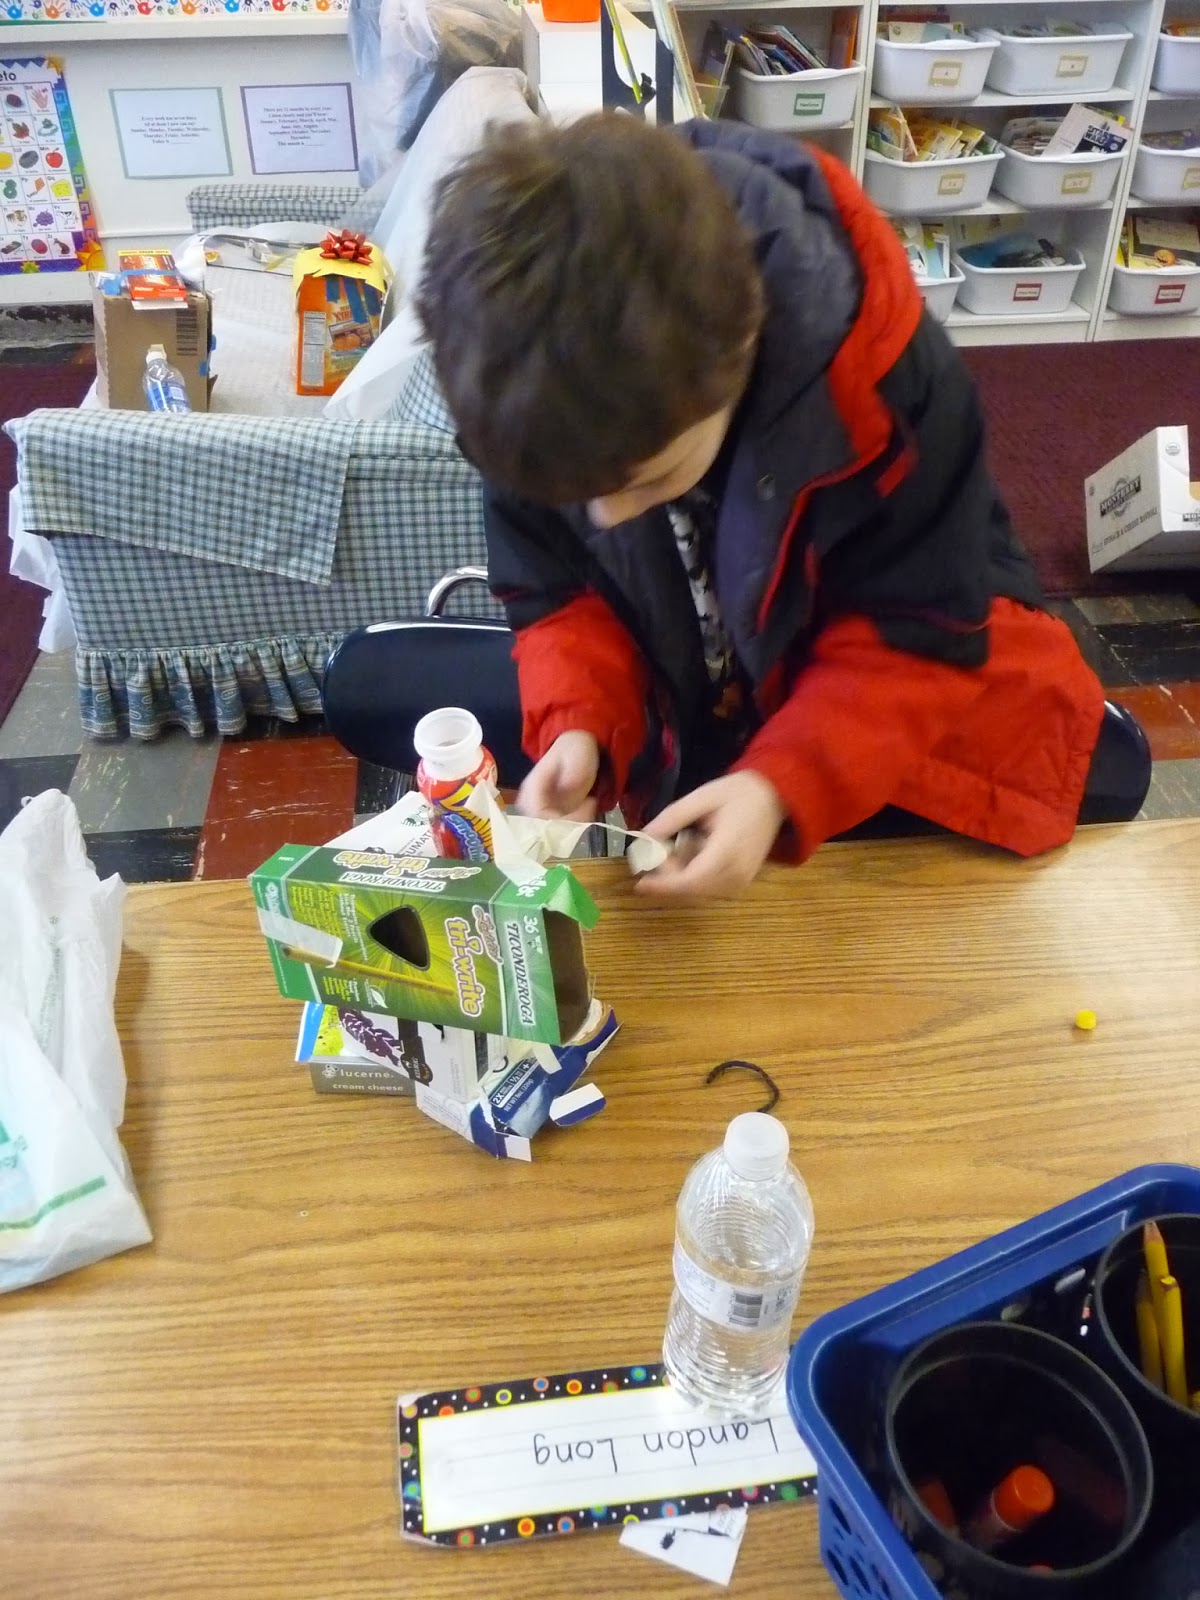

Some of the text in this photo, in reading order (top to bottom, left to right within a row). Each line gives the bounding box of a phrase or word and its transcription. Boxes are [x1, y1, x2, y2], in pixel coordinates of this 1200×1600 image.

[339, 871, 444, 892] TICONDEROGA
[523, 914, 540, 934] 36
[445, 917, 485, 1017] tri-write
[506, 921, 535, 1025] TICONDEROGA
[493, 1092, 505, 1104] 2X
[532, 1417, 779, 1474] Landon Long
